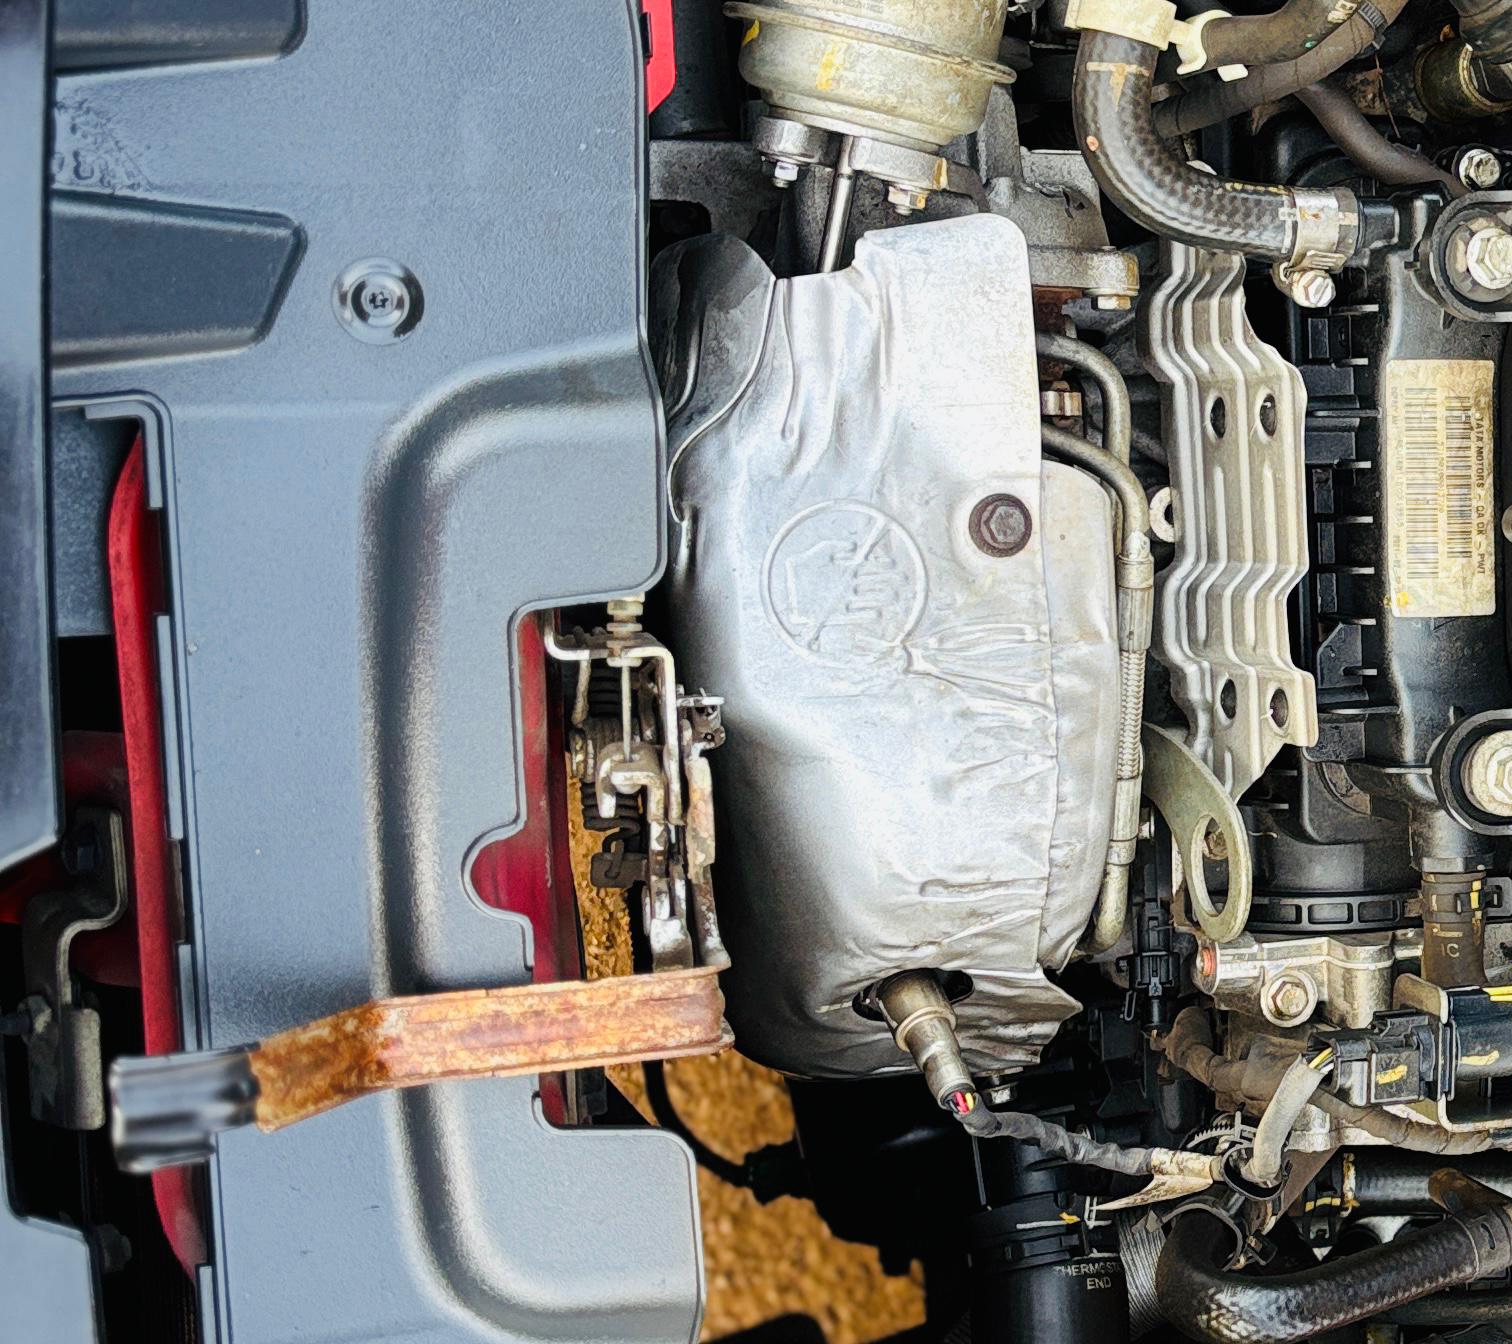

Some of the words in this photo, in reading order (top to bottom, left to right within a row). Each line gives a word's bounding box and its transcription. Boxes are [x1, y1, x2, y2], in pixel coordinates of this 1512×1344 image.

[1475, 417, 1486, 442] TATA
[1475, 446, 1487, 488] MOTORS
[1086, 1277, 1112, 1289] END
